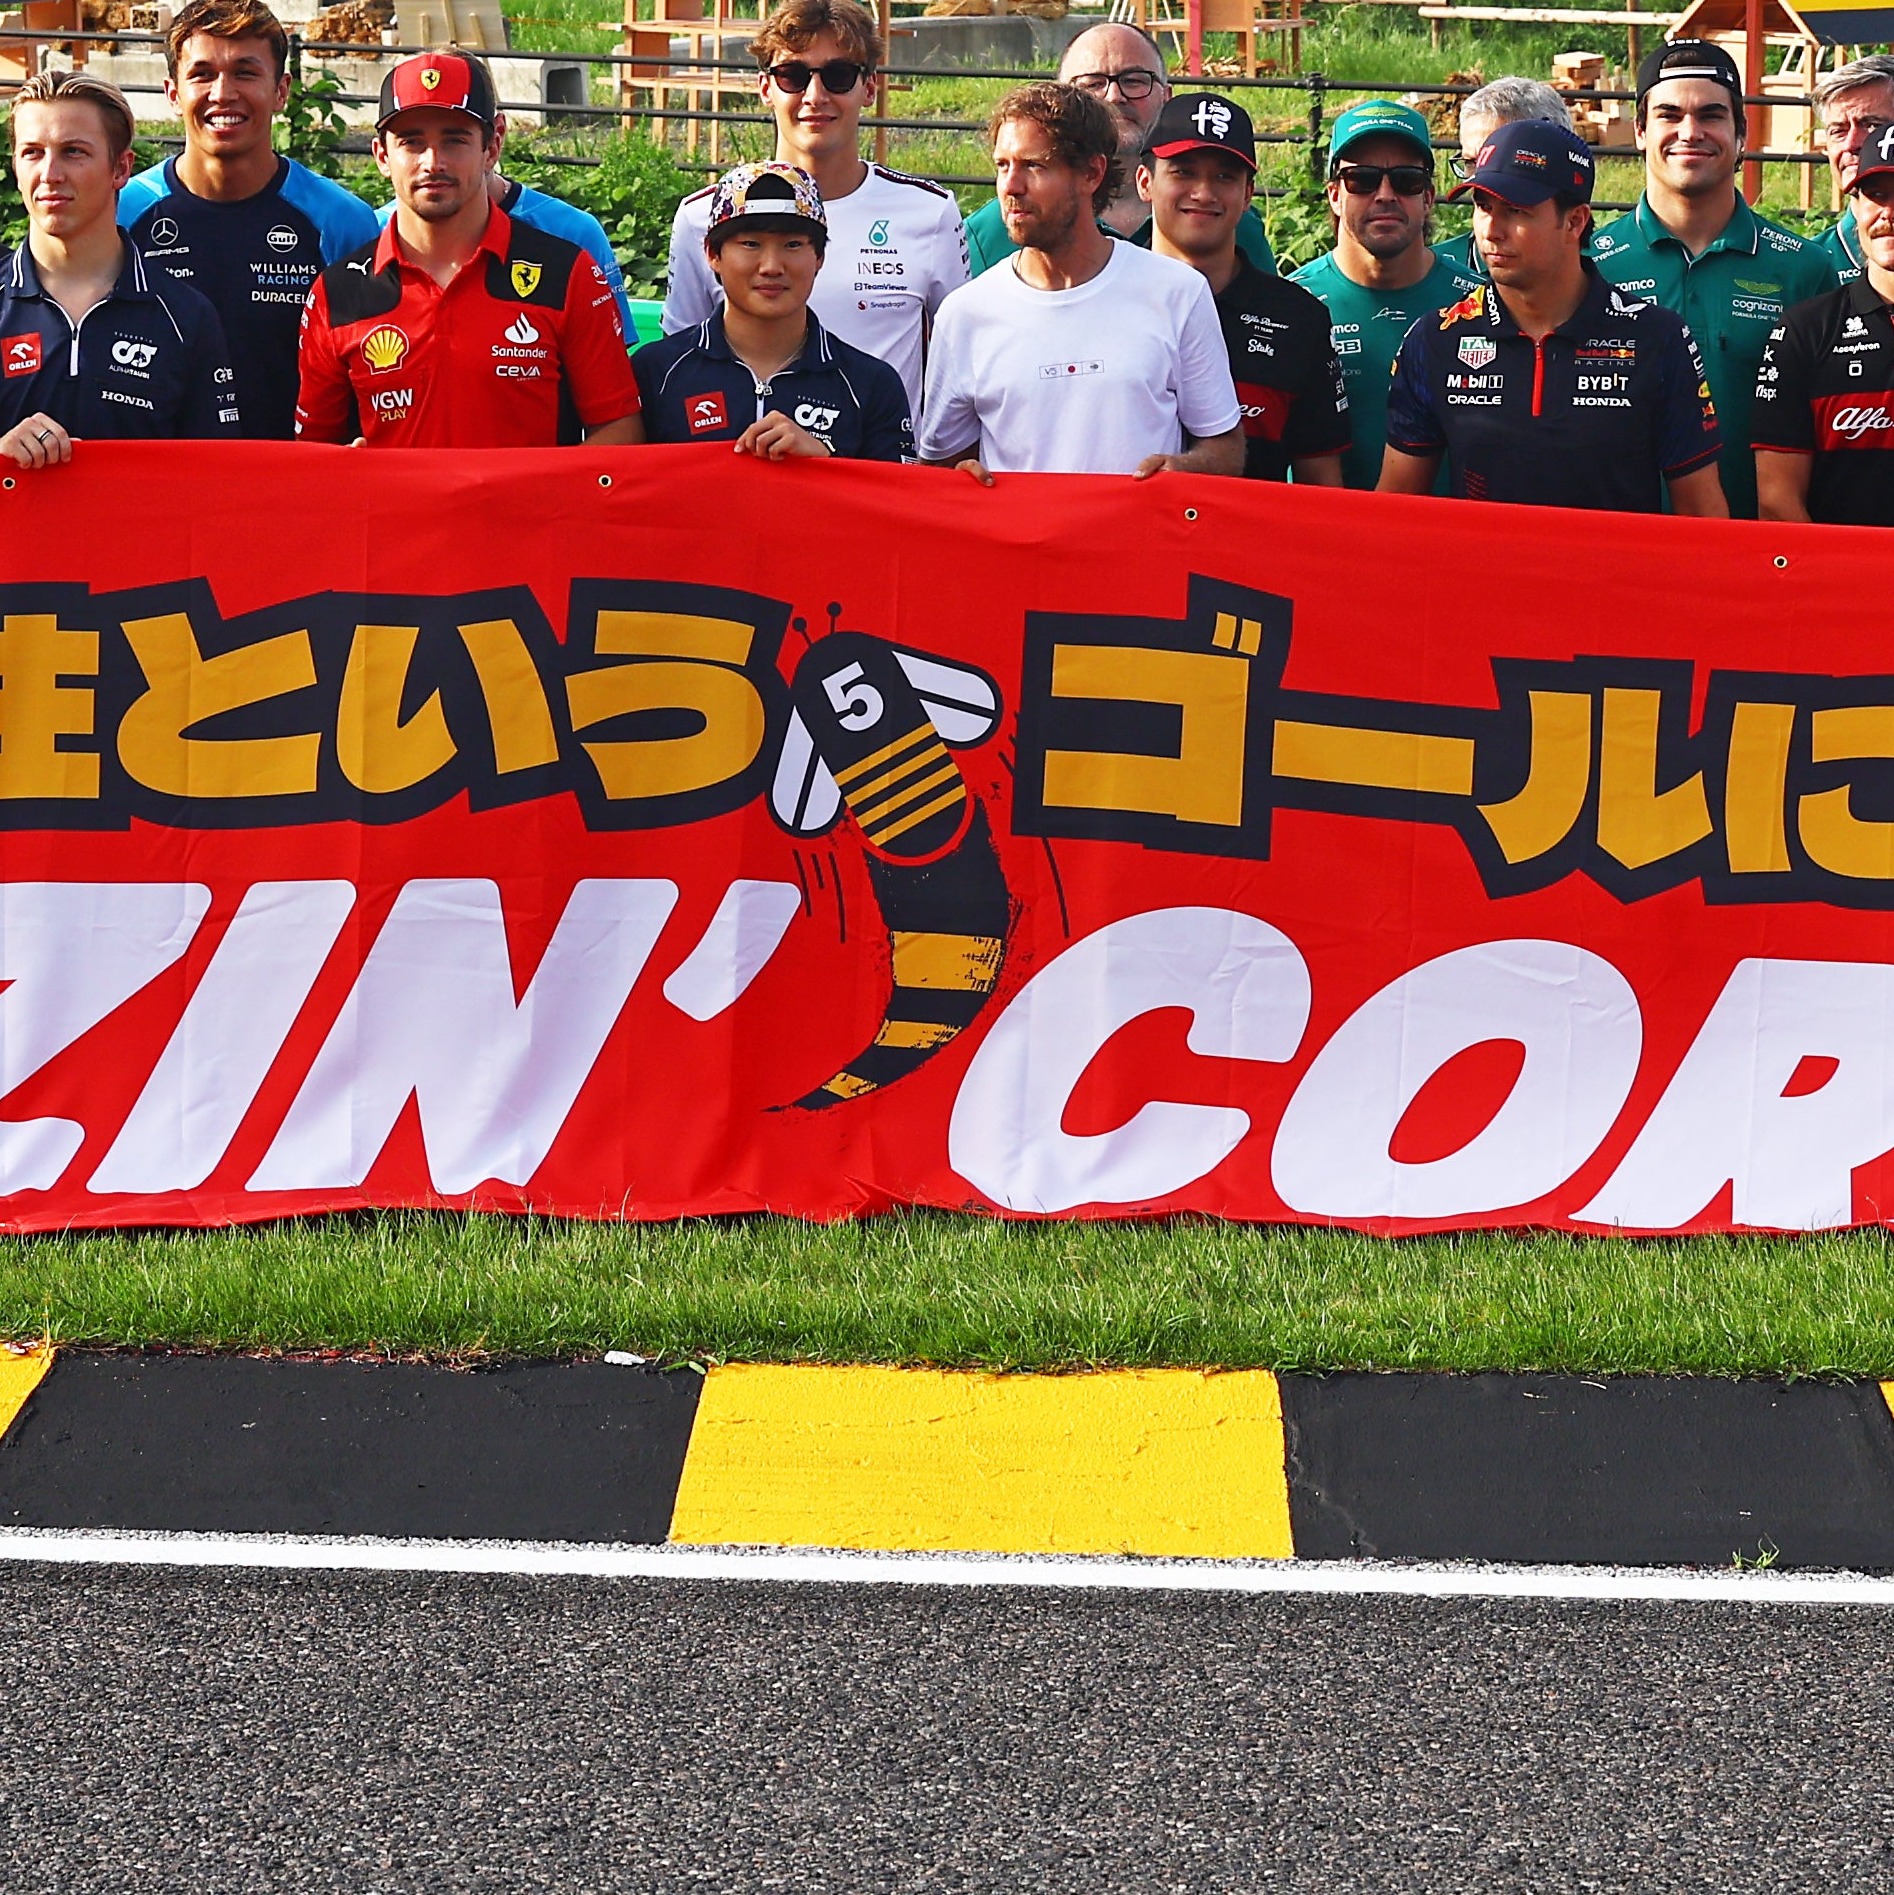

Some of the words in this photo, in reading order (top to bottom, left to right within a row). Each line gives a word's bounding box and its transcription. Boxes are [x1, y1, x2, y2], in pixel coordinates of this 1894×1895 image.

[268, 232, 297, 245] Gulf
[1761, 227, 1803, 250] PERONI
[860, 248, 898, 256] PETRONAS
[249, 263, 318, 275] WILLIAMS
[857, 262, 904, 276] INEOS
[257, 274, 310, 286] RACING
[251, 290, 307, 305] DURACEL
[870, 300, 907, 309] Snapdragon
[1486, 285, 1502, 326] zoom
[1247, 338, 1274, 357] Stake
[1463, 337, 1495, 350] TAG
[491, 345, 548, 359] Santander
[1461, 349, 1496, 362] HEUER
[8, 359, 37, 372] ORLEN
[1447, 374, 1487, 389] Mobil
[1577, 372, 1629, 391] BYBIT
[101, 390, 154, 410] HONDA
[371, 388, 413, 412] VGW
[1447, 395, 1502, 405] ORACLE
[1572, 396, 1632, 407] HONDA
[380, 408, 407, 423] PLAY
[694, 415, 723, 429] ORLEN
[1833, 407, 1894, 440] Alfa
[821, 660, 884, 732] 5
